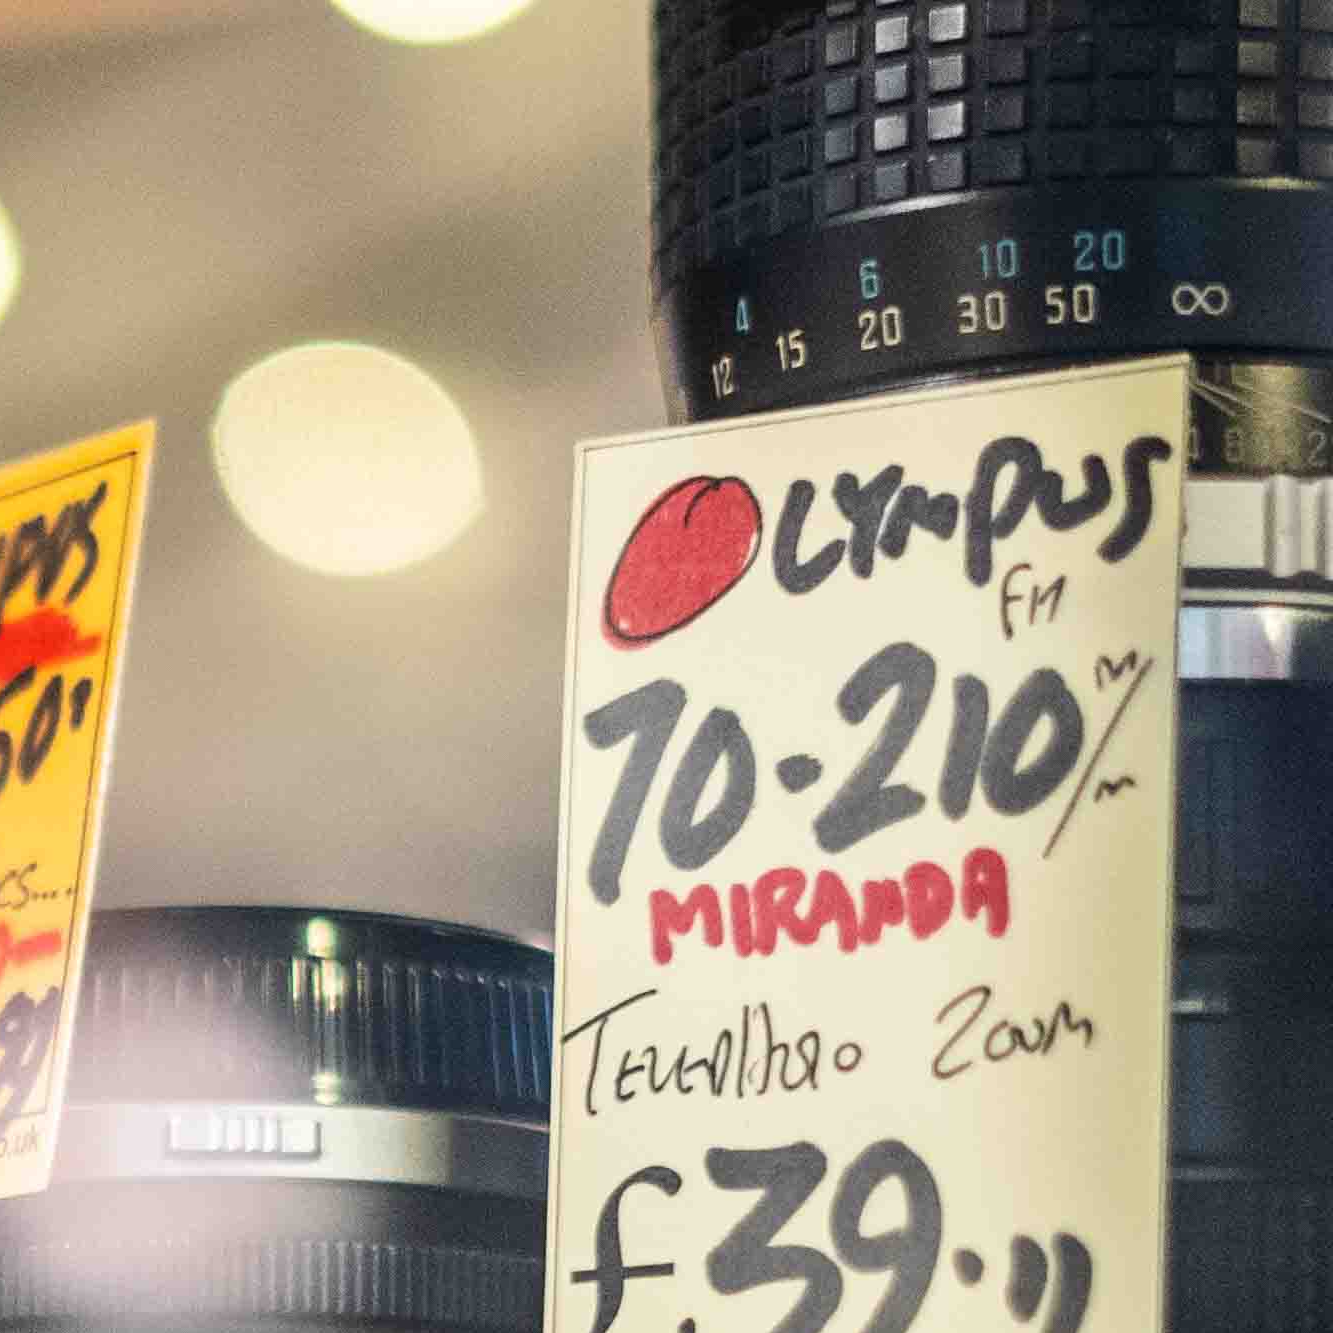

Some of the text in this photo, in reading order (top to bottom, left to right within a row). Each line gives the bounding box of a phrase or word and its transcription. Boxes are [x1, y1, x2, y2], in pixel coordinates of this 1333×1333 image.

[736, 230, 1125, 332] 4 6 10 20
[711, 356, 734, 399] 12
[775, 330, 807, 374] 15
[859, 307, 903, 351] 20
[958, 292, 1005, 333] 30
[1045, 284, 1096, 325] 50
[649, 847, 1011, 965] MIRANDA
